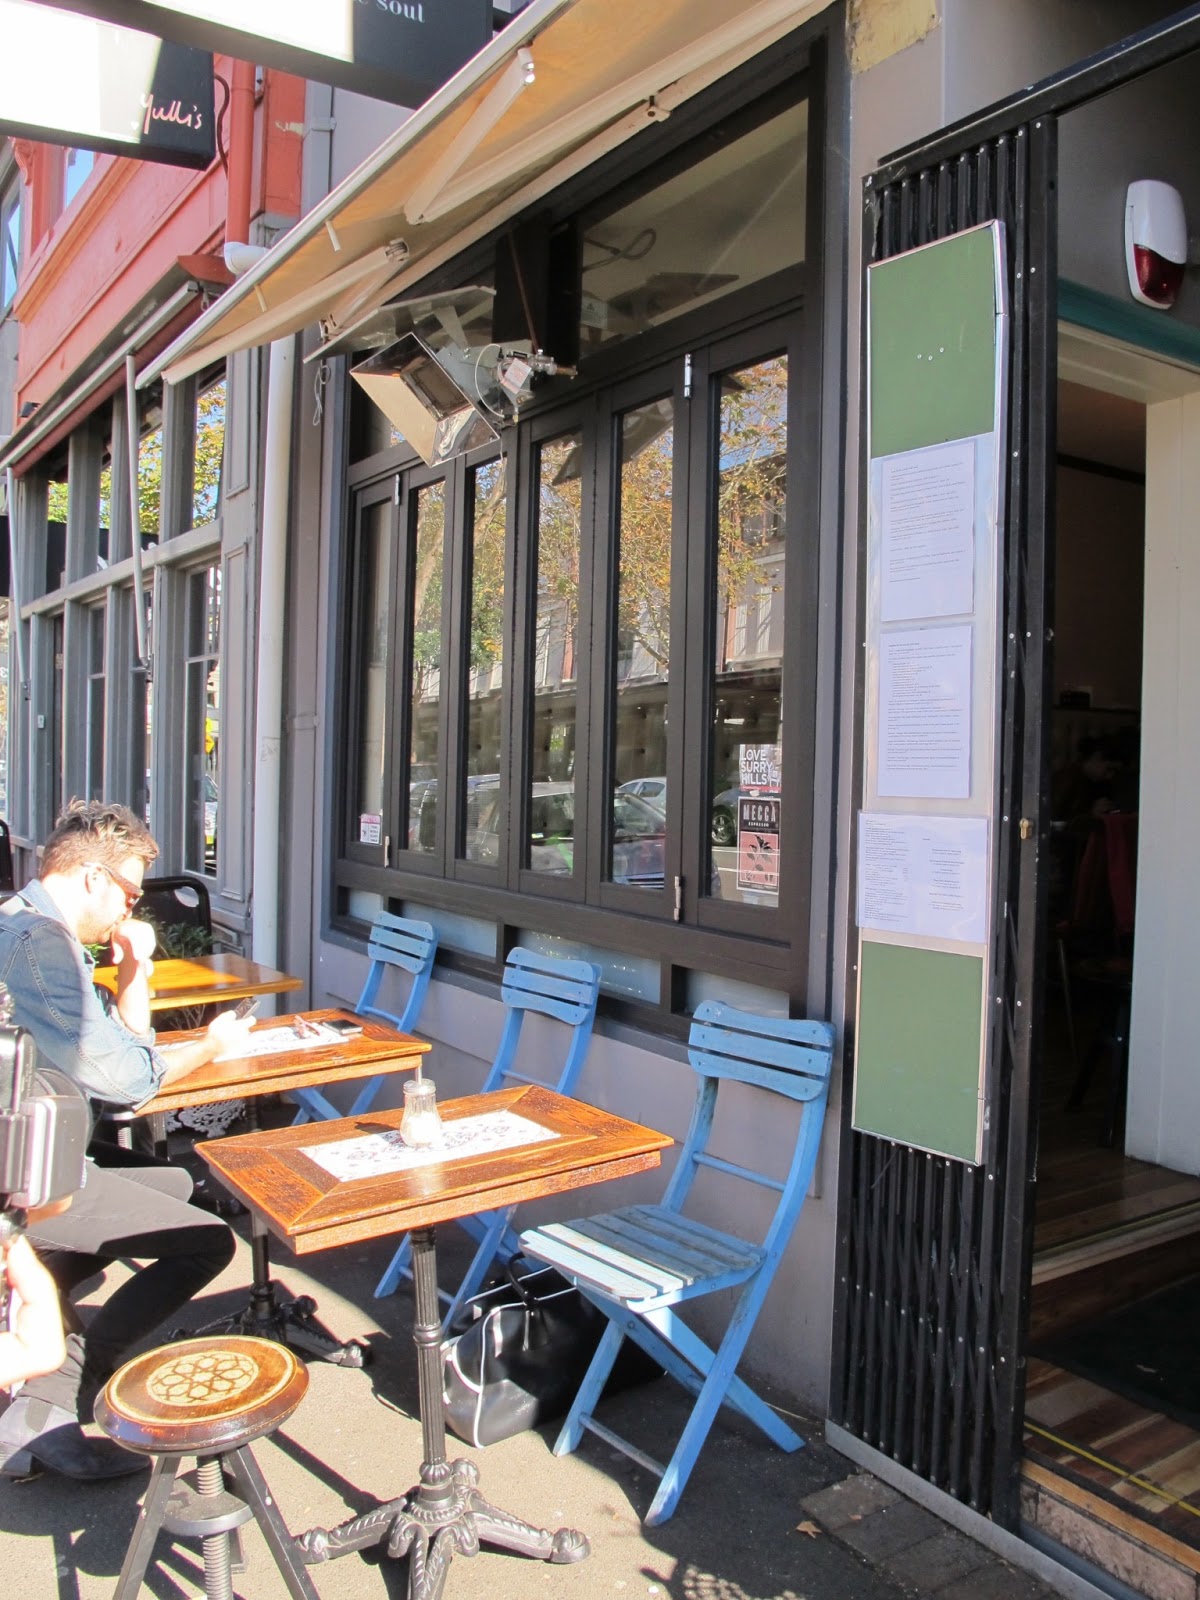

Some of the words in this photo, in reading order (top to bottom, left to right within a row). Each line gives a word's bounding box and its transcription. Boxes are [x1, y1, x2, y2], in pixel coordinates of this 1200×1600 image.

[376, 0, 425, 23] soul
[740, 748, 767, 761] LOVE
[740, 760, 773, 774] SURRY
[741, 773, 768, 785] HILLS
[743, 804, 776, 822] MECCA
